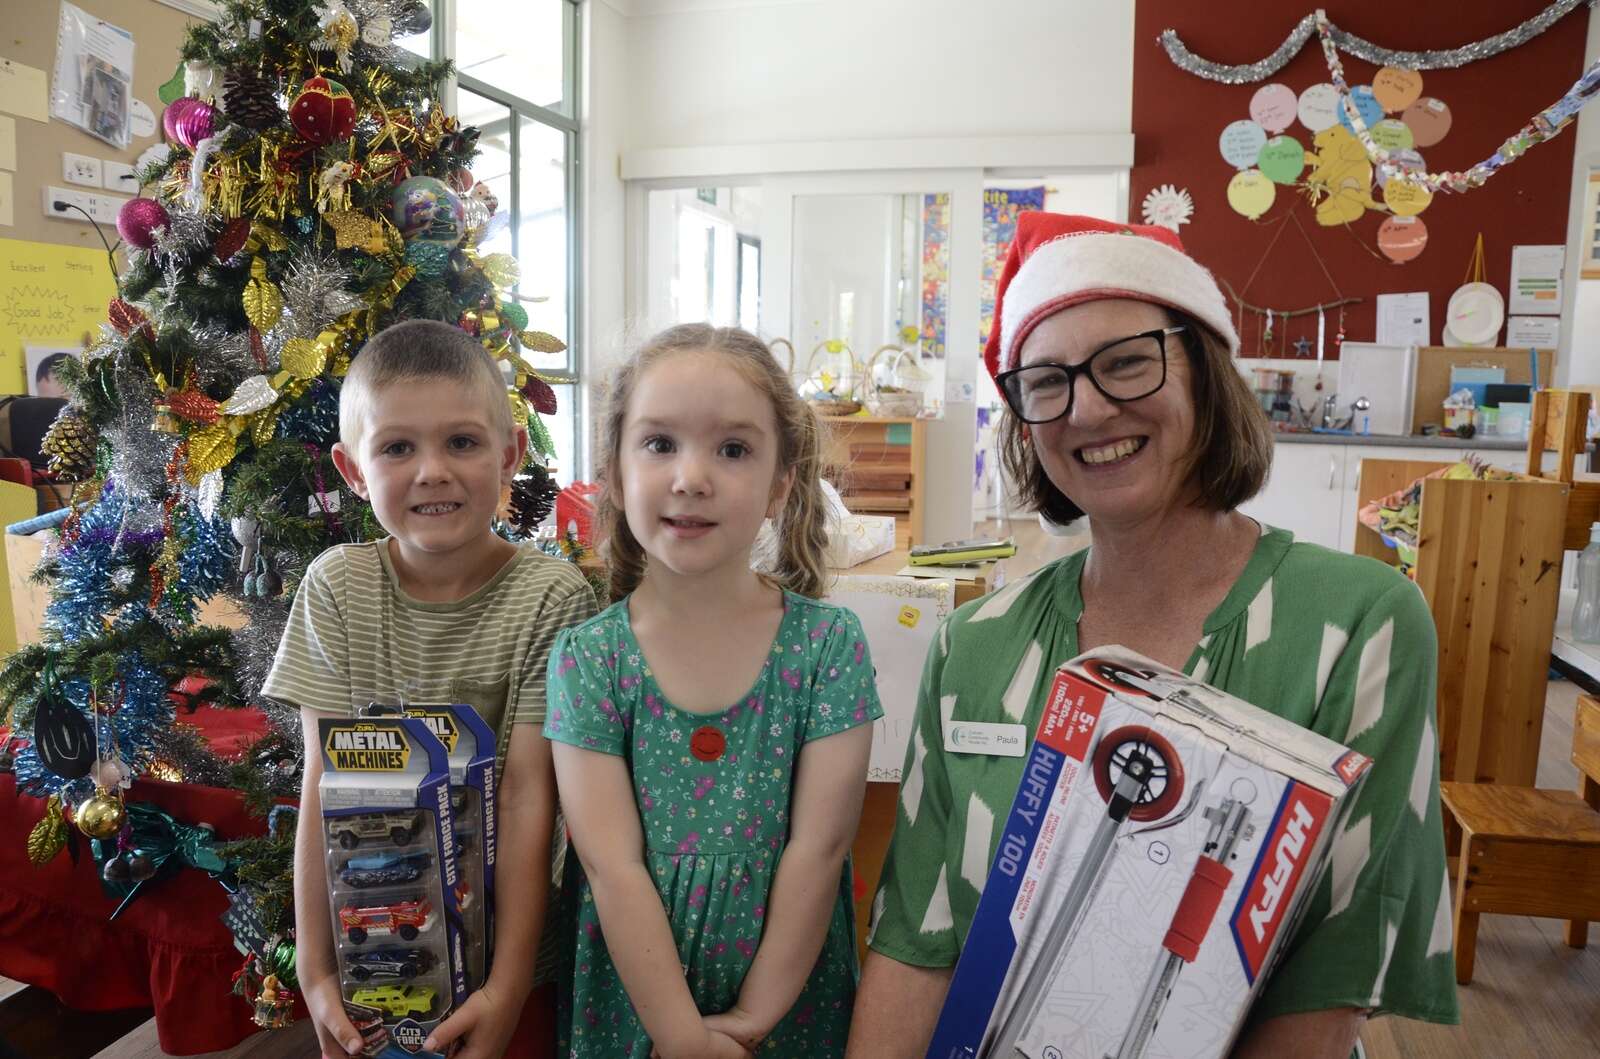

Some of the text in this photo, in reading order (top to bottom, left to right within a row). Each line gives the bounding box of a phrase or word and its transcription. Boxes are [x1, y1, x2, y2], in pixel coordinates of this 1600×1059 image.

[14, 302, 64, 319] Good Job
[1044, 713, 1057, 736] MAX
[1078, 712, 1096, 733] 5+
[335, 732, 402, 750] METAL
[996, 736, 1018, 744] Paula
[337, 752, 404, 768] MACHINES
[483, 766, 495, 866] CITY FORCE PACK
[998, 747, 1056, 877] HUFFY 100
[437, 784, 456, 886] CITY FORCE PACK
[1248, 800, 1314, 944] HUFFY
[456, 983, 465, 992] 5
[396, 1036, 426, 1044] FORCE
[400, 1026, 420, 1036] CITY
